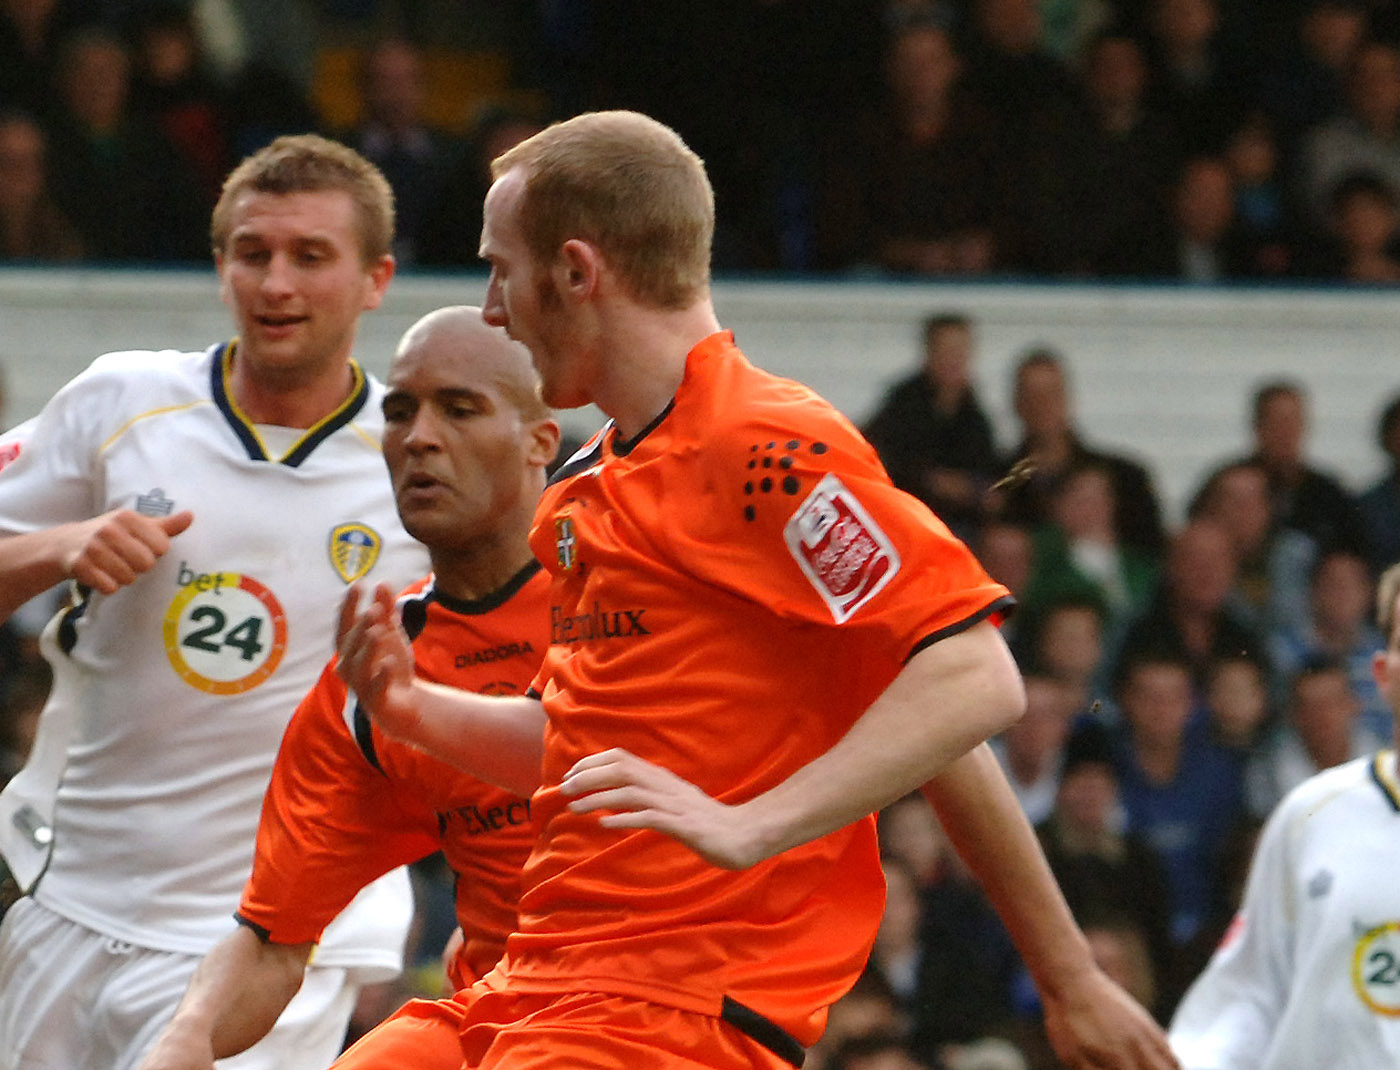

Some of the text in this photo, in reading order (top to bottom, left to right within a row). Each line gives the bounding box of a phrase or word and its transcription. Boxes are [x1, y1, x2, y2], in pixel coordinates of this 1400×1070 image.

[177, 561, 225, 595] bet
[181, 604, 264, 662] 24
[454, 641, 535, 669] DIADORA
[1366, 949, 1400, 986] 2
